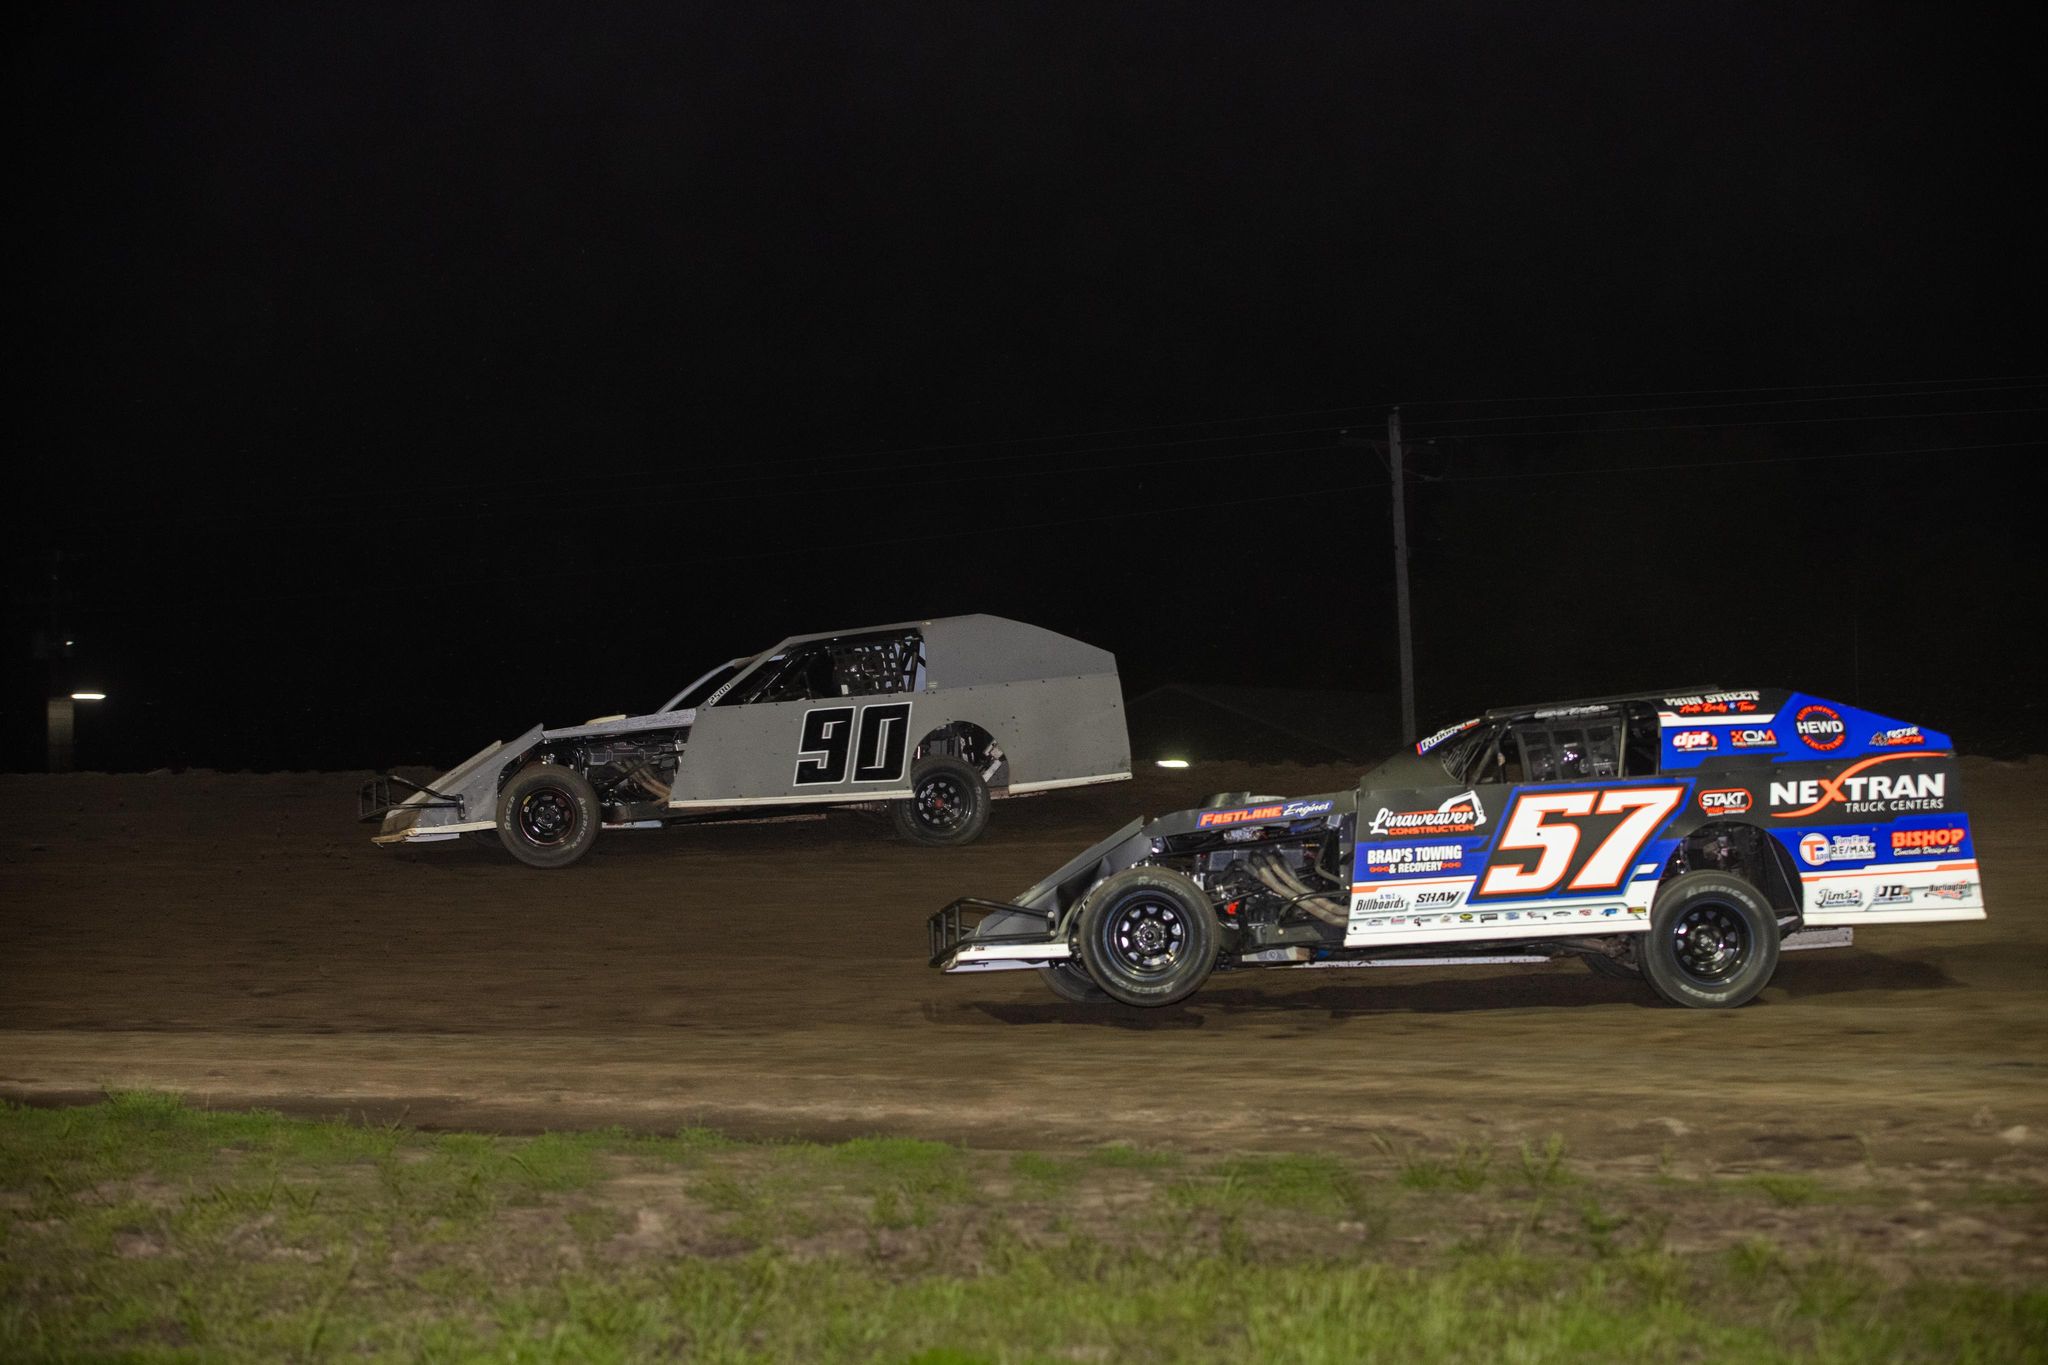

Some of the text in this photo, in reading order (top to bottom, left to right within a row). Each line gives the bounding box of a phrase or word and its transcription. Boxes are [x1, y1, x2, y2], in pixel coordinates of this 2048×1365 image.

[1796, 720, 1844, 734] HEWD
[793, 702, 912, 787] 90
[1769, 772, 1946, 808] NEXTRAN
[1702, 791, 1746, 807] STAKT
[1844, 799, 1944, 813] TRUCK CENTERS
[1199, 803, 1330, 826] FASTLANE Engines
[1368, 807, 1475, 835] Linaweaver
[1388, 824, 1475, 836] CONSTRUCTION
[1891, 828, 1965, 848] BISHOP
[1480, 787, 1684, 895] 57
[1367, 845, 1463, 864] BRAD'S TOWING
[1830, 845, 1875, 855] RE/MAX
[1388, 861, 1443, 874] & RECOVERY
[1356, 897, 1405, 911] Billboards
[1416, 891, 1460, 903] SHAW
